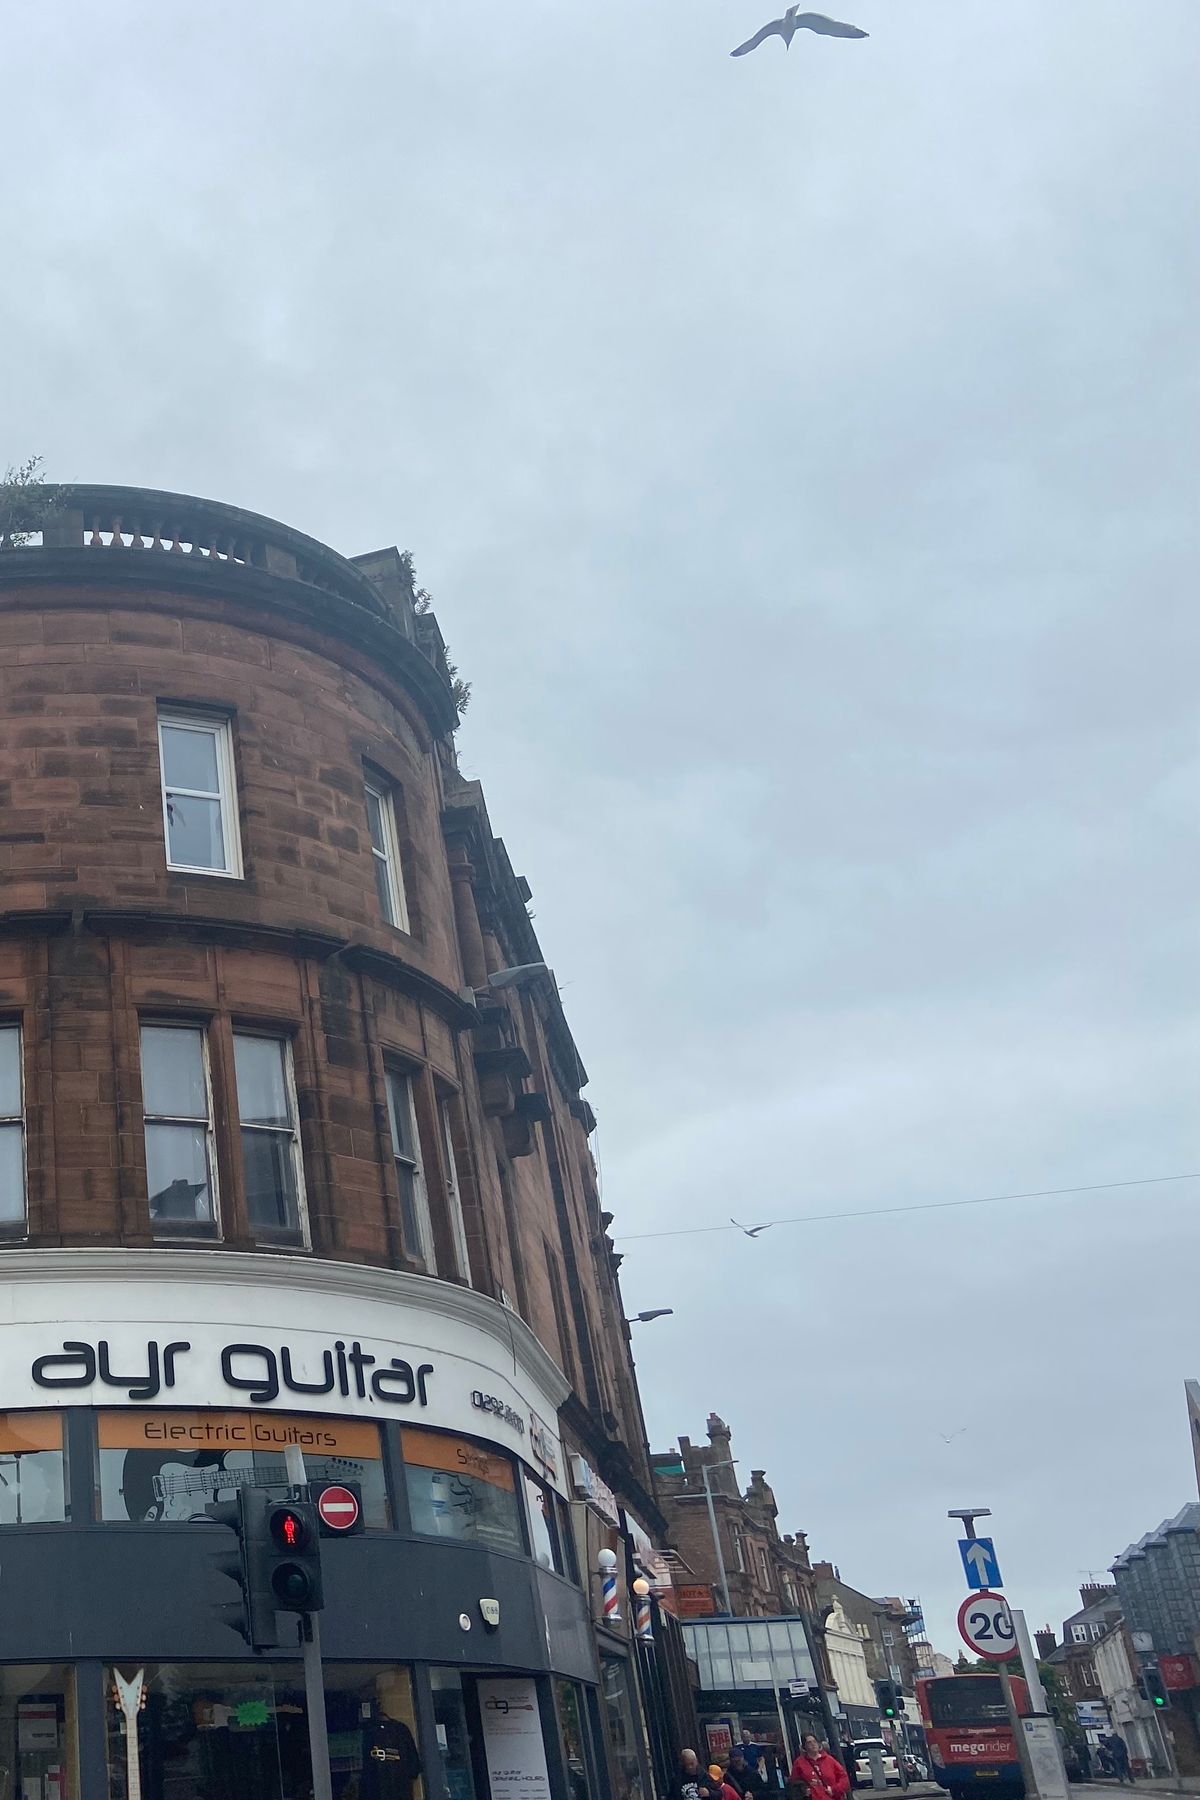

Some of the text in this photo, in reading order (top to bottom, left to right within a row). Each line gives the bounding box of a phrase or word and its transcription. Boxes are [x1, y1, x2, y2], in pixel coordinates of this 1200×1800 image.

[31, 1340, 434, 1406] ayr guitar
[143, 1420, 338, 1447] Electric Guitars
[969, 1612, 1014, 1640] 20
[949, 1740, 1011, 1756] megarider
